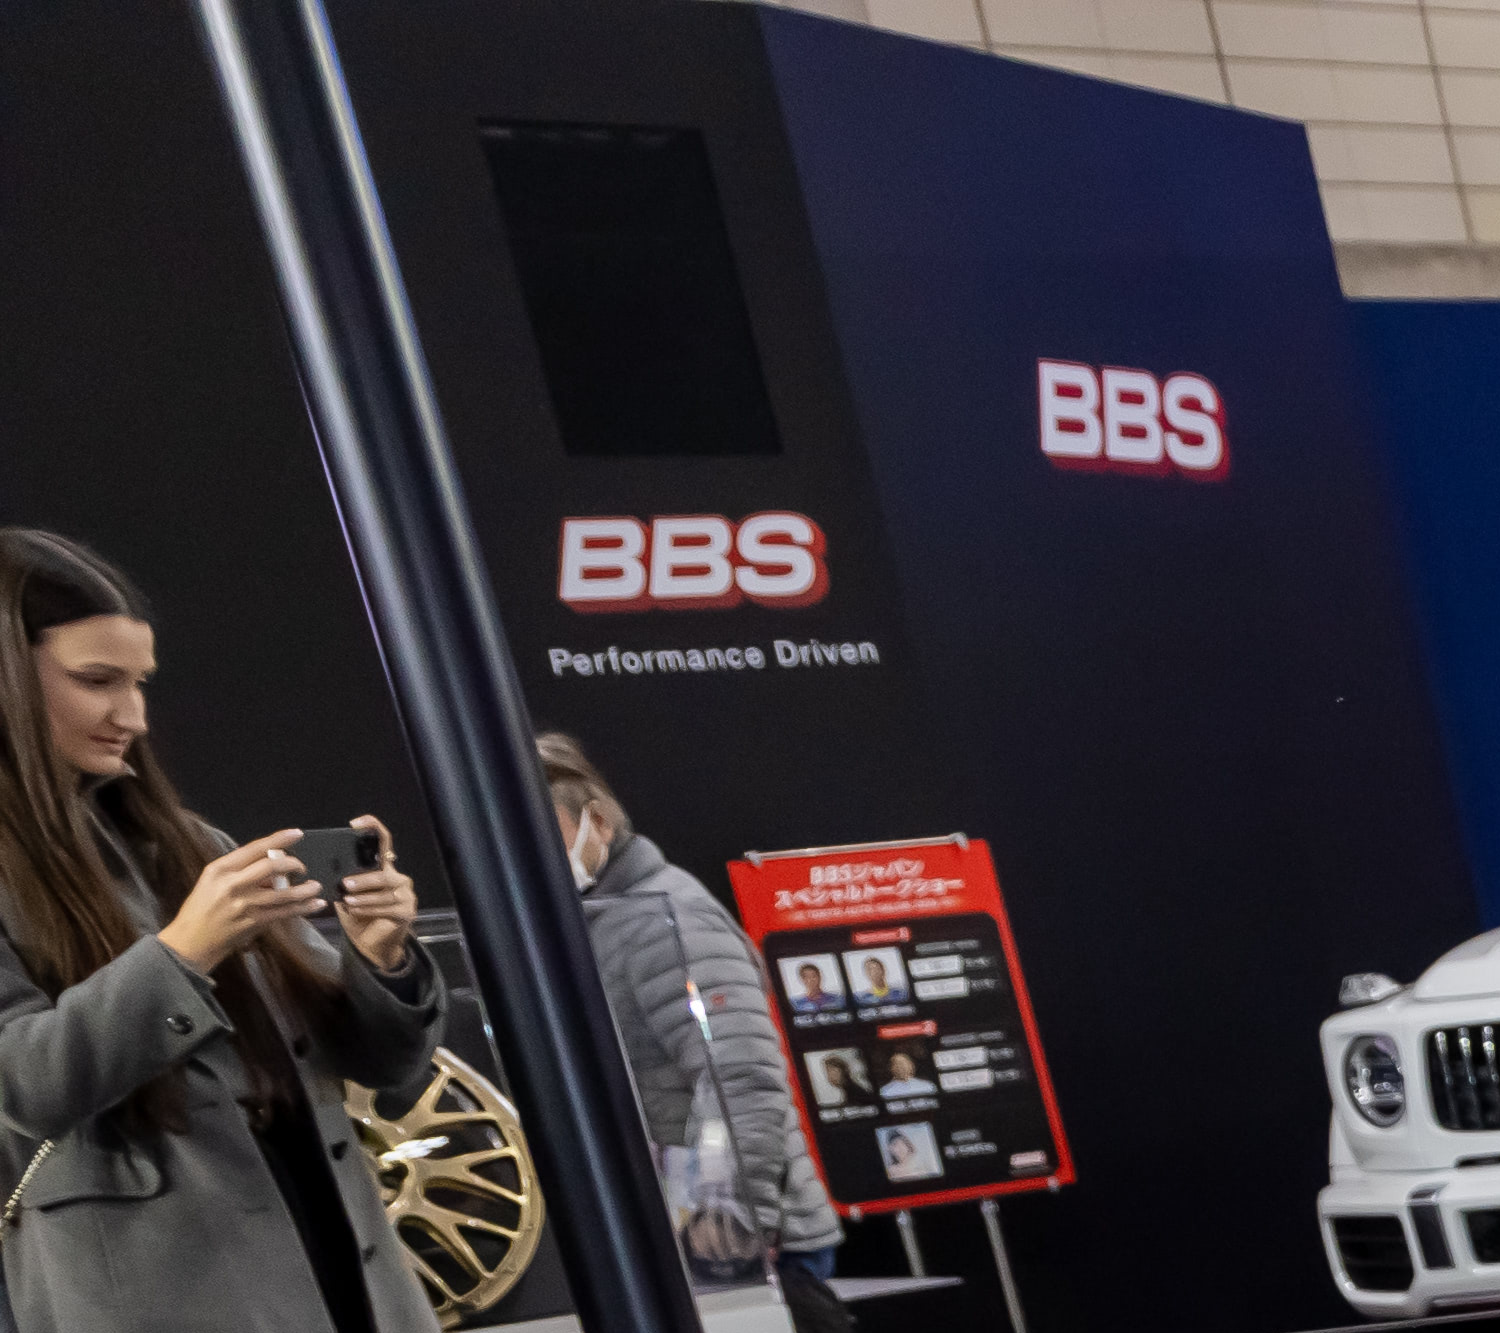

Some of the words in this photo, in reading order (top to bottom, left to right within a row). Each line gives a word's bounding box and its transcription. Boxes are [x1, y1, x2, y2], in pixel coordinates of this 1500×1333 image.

[1038, 358, 1230, 482] BBS
[558, 511, 830, 613] BBS
[548, 640, 766, 679] Performance
[773, 636, 881, 670] Driven
